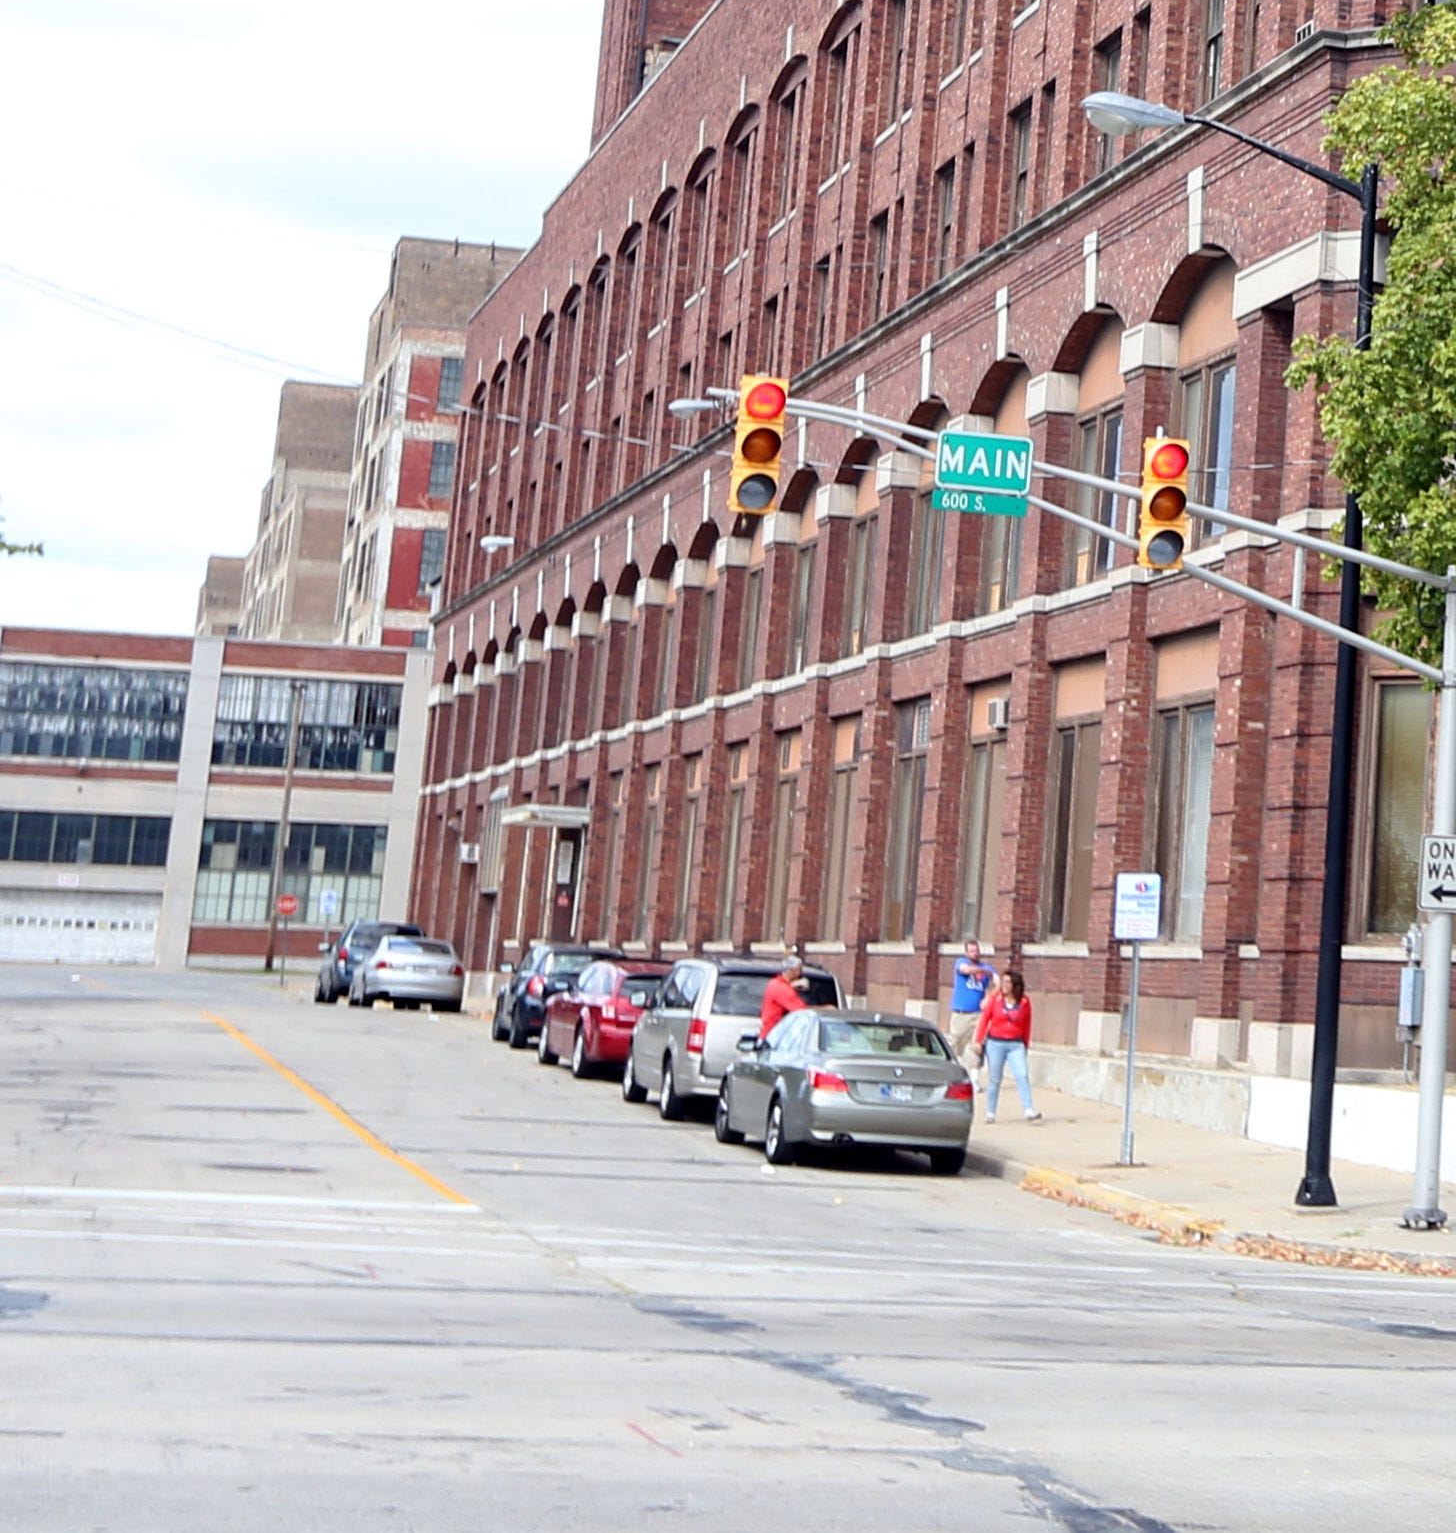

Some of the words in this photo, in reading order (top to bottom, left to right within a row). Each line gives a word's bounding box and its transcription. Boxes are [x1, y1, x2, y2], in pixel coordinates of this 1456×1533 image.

[941, 444, 1026, 480] MAIN
[941, 493, 968, 510] 600
[974, 495, 986, 512] S.
